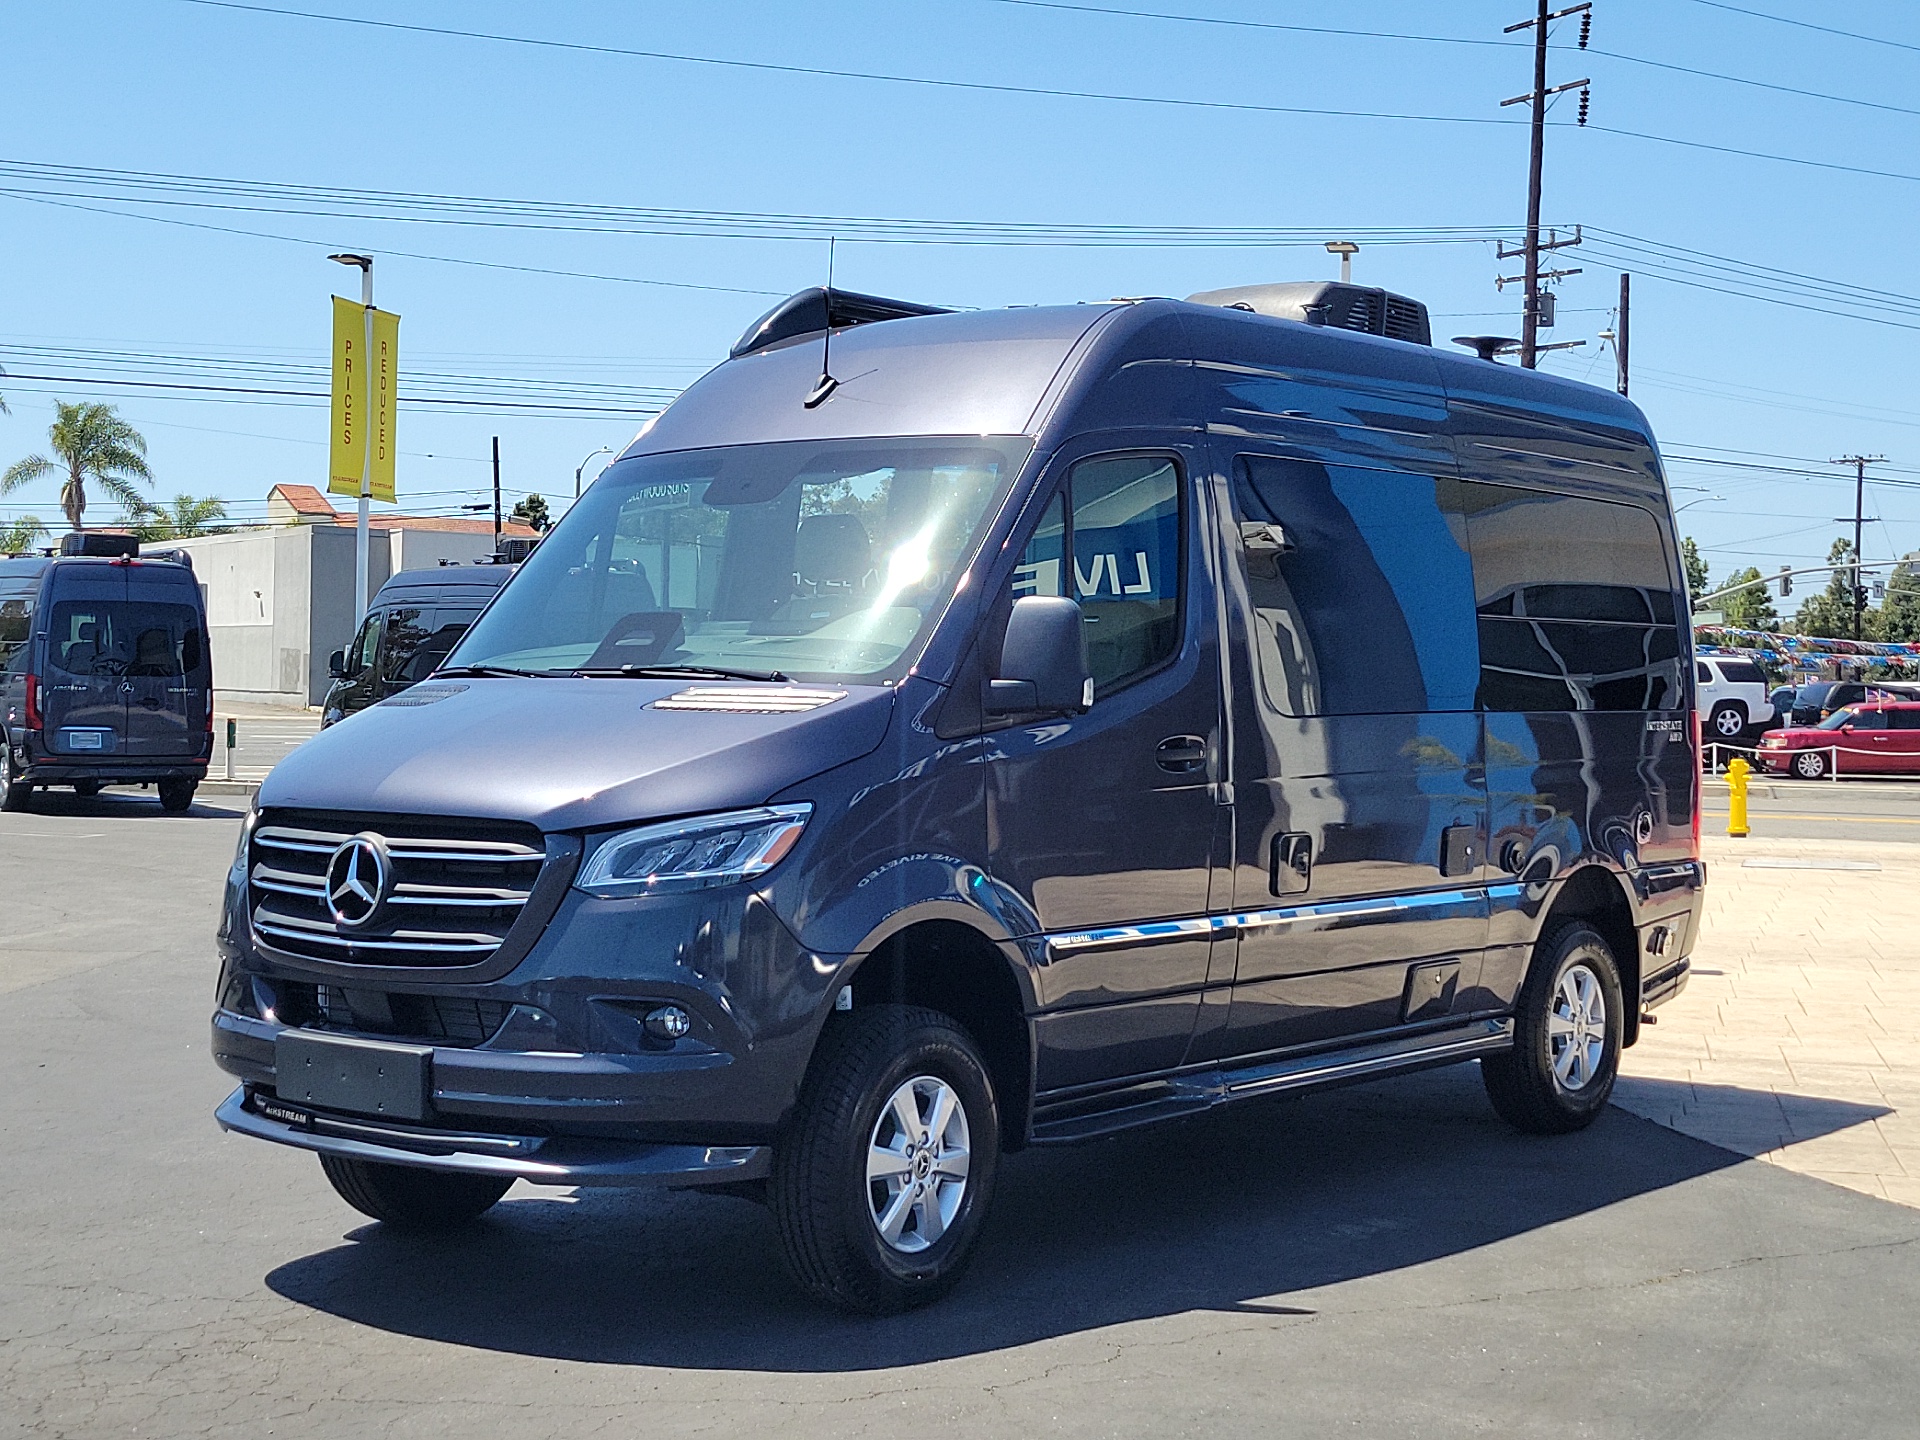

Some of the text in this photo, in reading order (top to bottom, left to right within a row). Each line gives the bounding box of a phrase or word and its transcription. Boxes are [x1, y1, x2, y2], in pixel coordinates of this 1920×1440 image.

[344, 340, 352, 444] PRICES
[379, 341, 387, 460] REDUCED
[266, 1107, 307, 1123] AIRSTREAM
